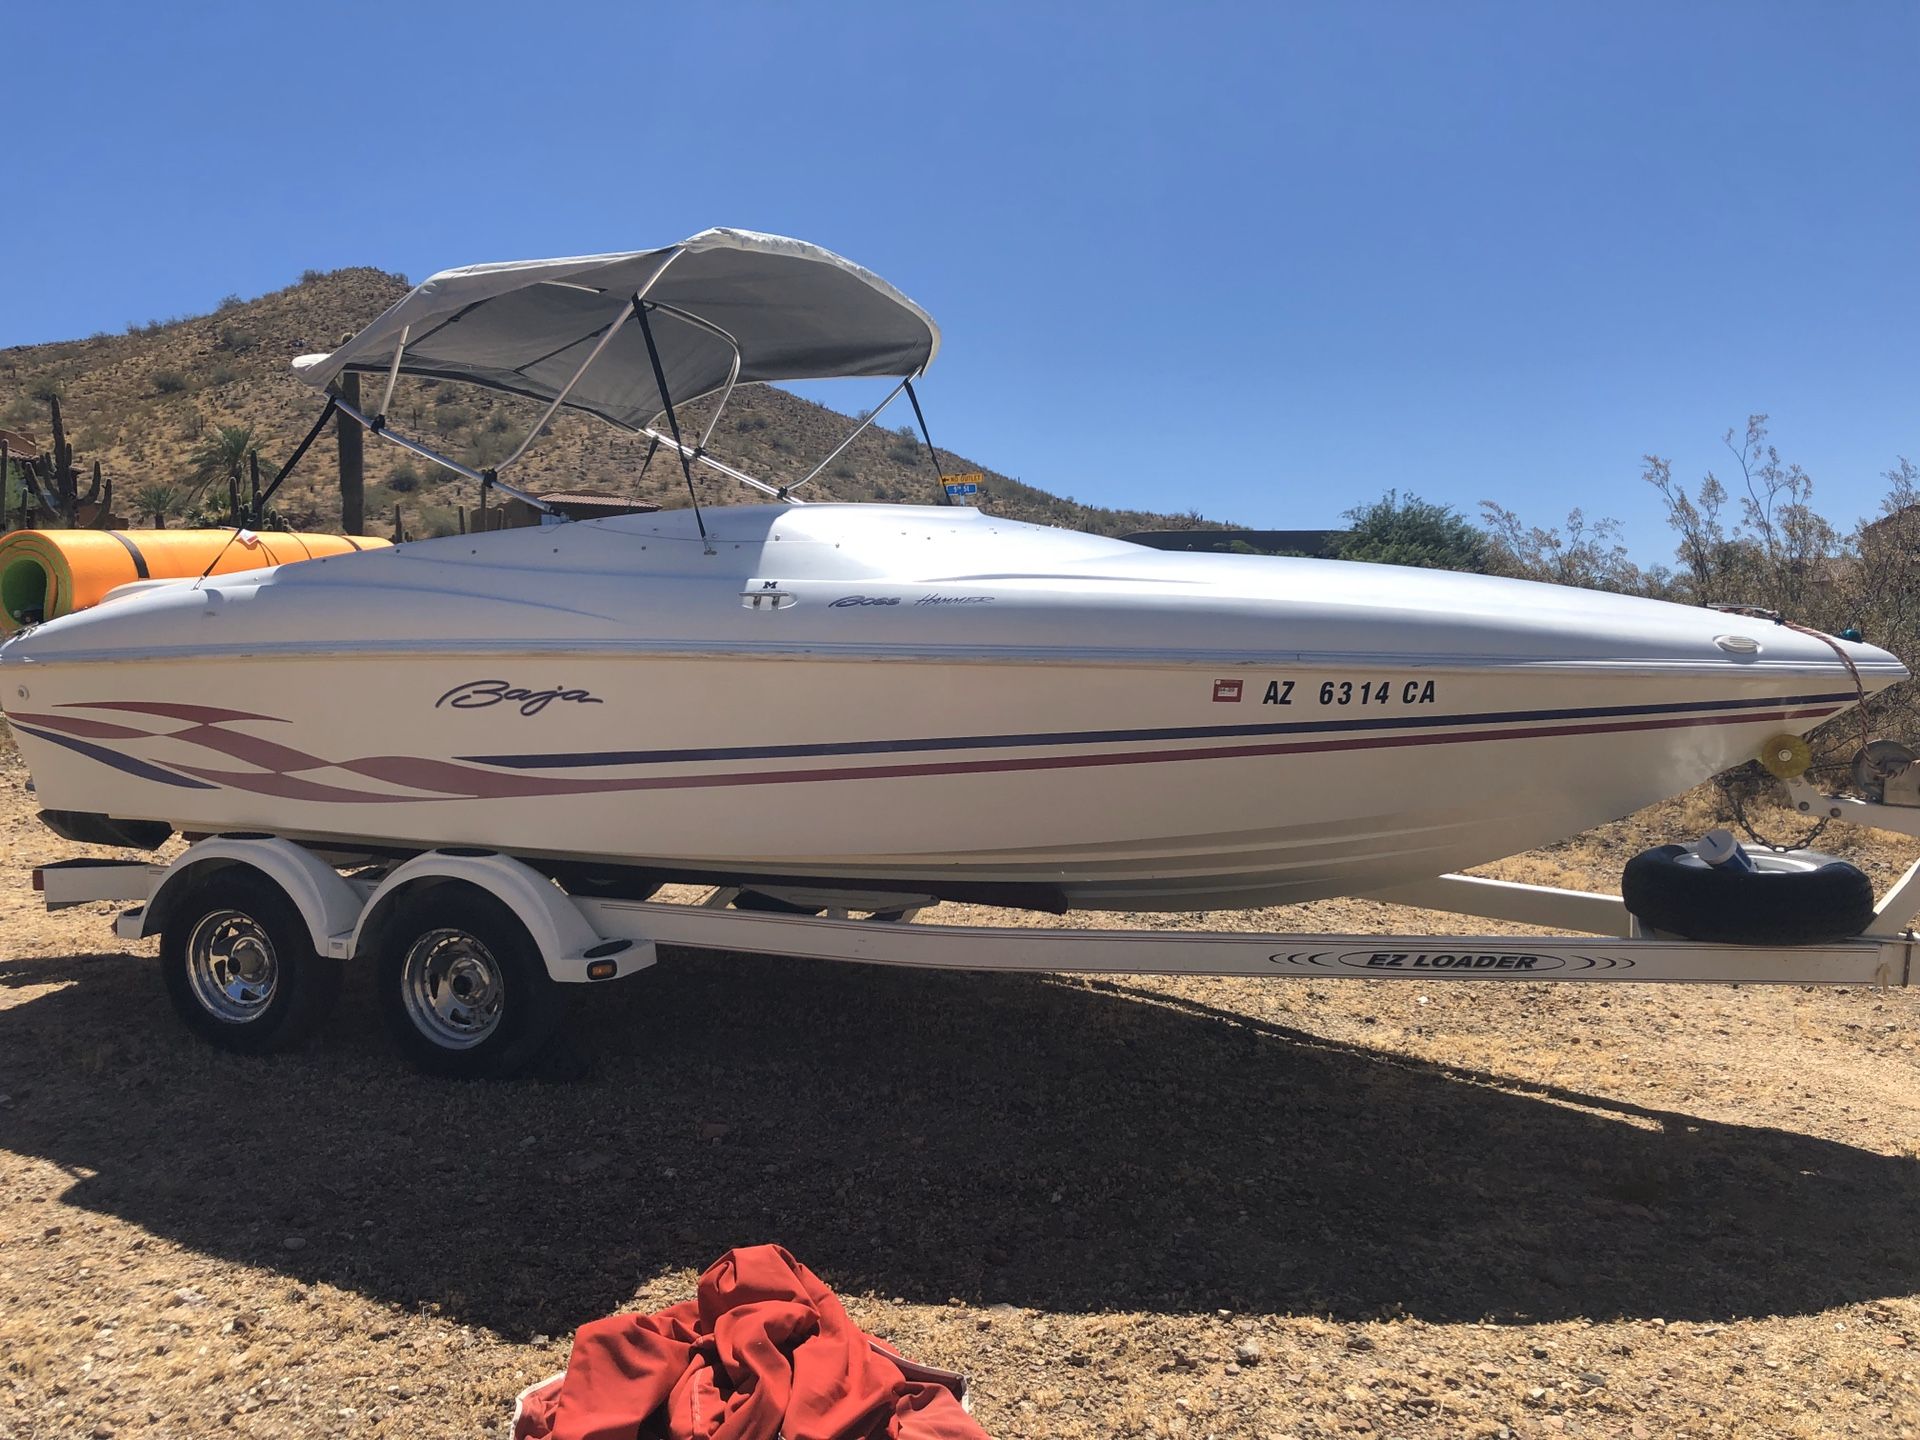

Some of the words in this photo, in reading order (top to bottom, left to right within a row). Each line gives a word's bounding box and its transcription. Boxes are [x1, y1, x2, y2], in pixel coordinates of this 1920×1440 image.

[763, 581, 778, 589] M
[914, 593, 995, 607] HAMMER
[435, 680, 604, 716] Baja
[1262, 681, 1295, 705] AZ
[1319, 681, 1390, 705] 6314
[1402, 680, 1435, 704] CA
[1366, 954, 1411, 968] EZ
[1413, 955, 1538, 970] LOADER
